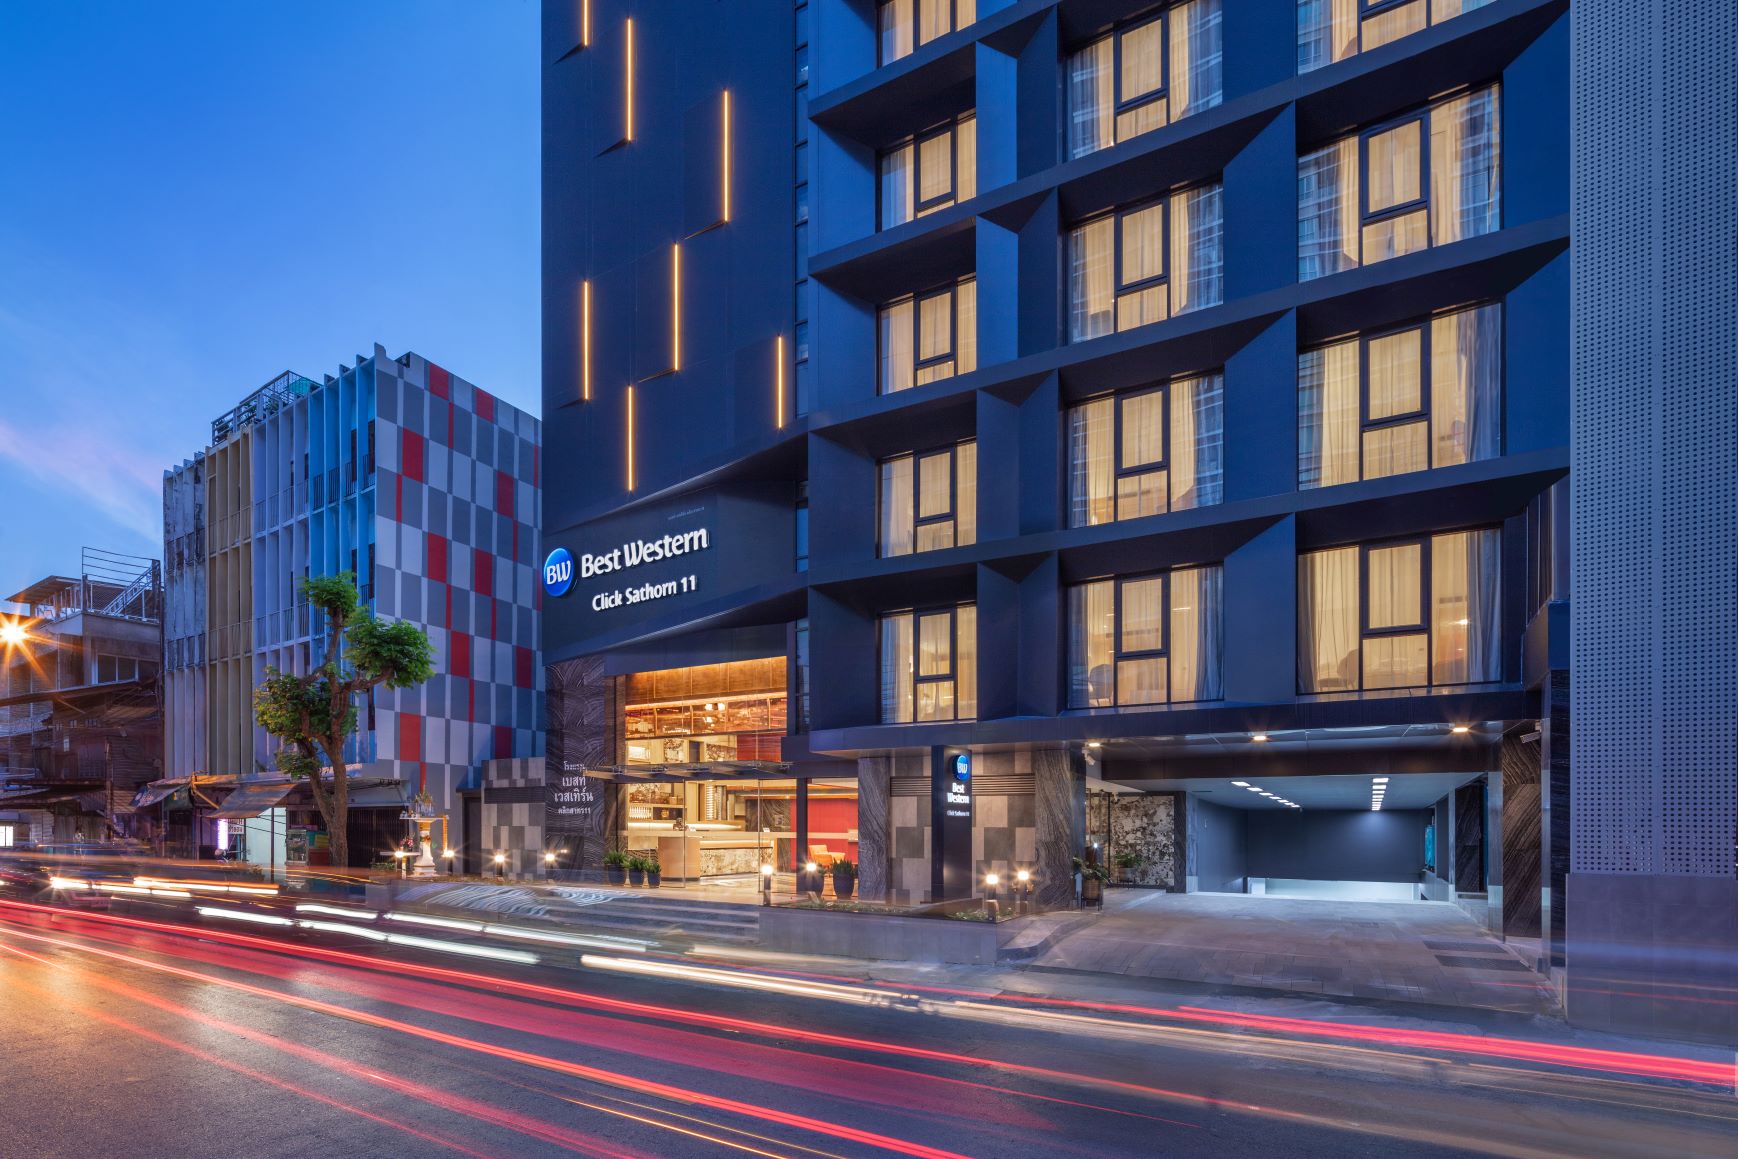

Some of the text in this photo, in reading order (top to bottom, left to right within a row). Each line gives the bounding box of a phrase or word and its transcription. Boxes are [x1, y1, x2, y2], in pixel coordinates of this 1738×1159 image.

[581, 528, 708, 578] Best Western
[546, 560, 571, 585] BW
[592, 574, 697, 612] Click Sathorn 11
[957, 763, 967, 773] BW
[952, 783, 964, 793] Best
[947, 793, 969, 803] Western
